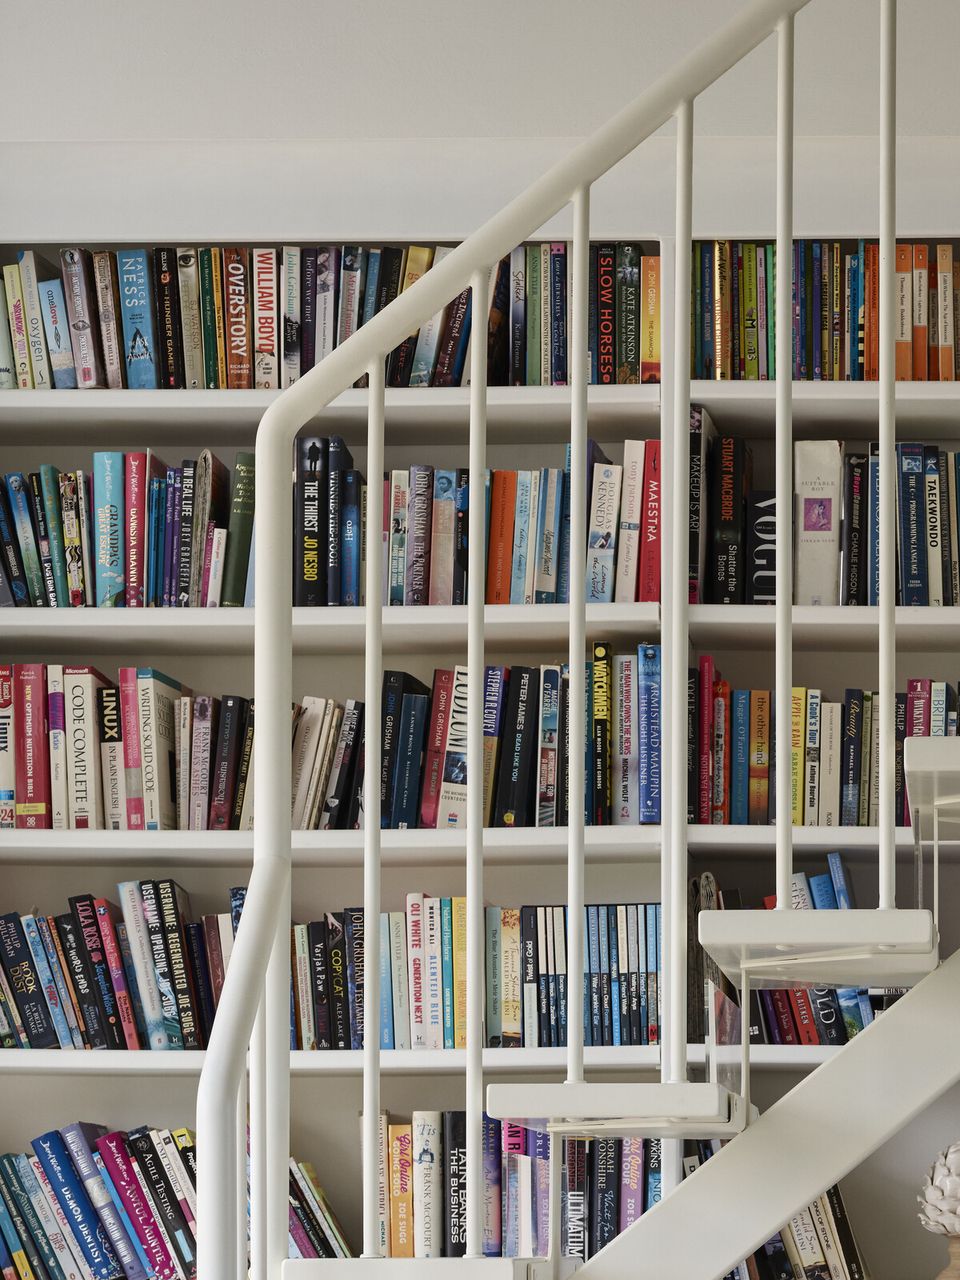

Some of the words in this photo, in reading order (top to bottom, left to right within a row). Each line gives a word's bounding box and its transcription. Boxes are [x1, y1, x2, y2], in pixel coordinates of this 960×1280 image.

[122, 259, 139, 307] NESS
[136, 257, 146, 305] PATRICK
[257, 252, 275, 311] WILLIAM
[512, 271, 526, 304] Stalked
[600, 257, 612, 303] SLOW
[164, 296, 172, 336] HUNGER
[228, 263, 247, 357] OVERSTORY
[31, 318, 44, 361] oxygen
[258, 316, 275, 352] BOYD
[600, 309, 613, 373] HORSES
[627, 317, 636, 362] ATKINSON
[722, 438, 734, 472] STUART
[304, 481, 318, 499] THE
[415, 470, 428, 495] JOHN
[691, 455, 700, 498] MAKEUP
[183, 496, 192, 516] LIFE
[595, 481, 606, 529] KENNEDY
[605, 483, 616, 530] DOUGLAS
[647, 481, 659, 542] MAESTRA
[721, 474, 734, 521] MACBRIDE
[928, 480, 938, 548] TAEKWONDO
[304, 501, 318, 532] THIRST
[329, 471, 338, 567] WINNIE-THE-POOH
[413, 496, 428, 537] GRISHAM
[304, 536, 318, 547] JO
[848, 532, 858, 564] CHARLIE
[180, 546, 190, 587] GRACEFFA
[413, 554, 424, 590] PARTNER
[717, 555, 727, 581] Bones
[728, 544, 737, 576] Shatter
[848, 565, 857, 594] HIGSON
[488, 670, 501, 700] STEPHEN
[521, 673, 529, 698] PETER
[594, 660, 607, 719] WATCHMEN
[72, 685, 85, 725] CODE
[103, 689, 118, 739] LINUX
[139, 687, 151, 734] WRITING
[484, 709, 497, 733] COVEY
[517, 700, 526, 729] JAMES
[649, 682, 660, 748] ARMISTEAD
[201, 726, 209, 754] FRANK
[383, 716, 394, 750] GRISHAM
[435, 711, 445, 747] GRISHAM
[756, 713, 767, 738] other
[74, 727, 88, 802] COMPLETE
[143, 735, 152, 764] SOLID
[756, 742, 766, 765] hand
[215, 762, 228, 805] Thomasina
[649, 752, 659, 798] MAUPIN
[701, 755, 710, 786] FASHION
[110, 778, 120, 809] ENGLISH
[701, 788, 710, 819] NAKED
[76, 900, 90, 923] LOLA
[159, 882, 176, 930] USERNAME:
[411, 903, 420, 917] OLI
[7, 923, 20, 949] PHILIP
[82, 923, 100, 950] ROSE
[142, 883, 158, 931] USERNAME:
[151, 933, 168, 973] UPRISING
[411, 919, 421, 948] WHITE
[19, 961, 37, 994] BOOK
[69, 948, 82, 973] WORLD
[167, 932, 185, 990] REGENERATED
[331, 949, 345, 998] COPYCAT
[429, 955, 438, 998] ALENTEJO
[10, 967, 27, 993] DUST
[412, 958, 422, 1002] GENERATION
[178, 994, 189, 1010] JOE
[414, 1004, 423, 1024] NEXT
[430, 1002, 439, 1025] BLUE
[182, 1011, 194, 1033] SUGG
[163, 1161, 180, 1193] Distilled
[155, 1182, 174, 1220] TESTING
[62, 1187, 82, 1222] DEMON
[79, 1224, 103, 1264] DENTIST
[568, 1192, 584, 1258] ULTIMATUM
